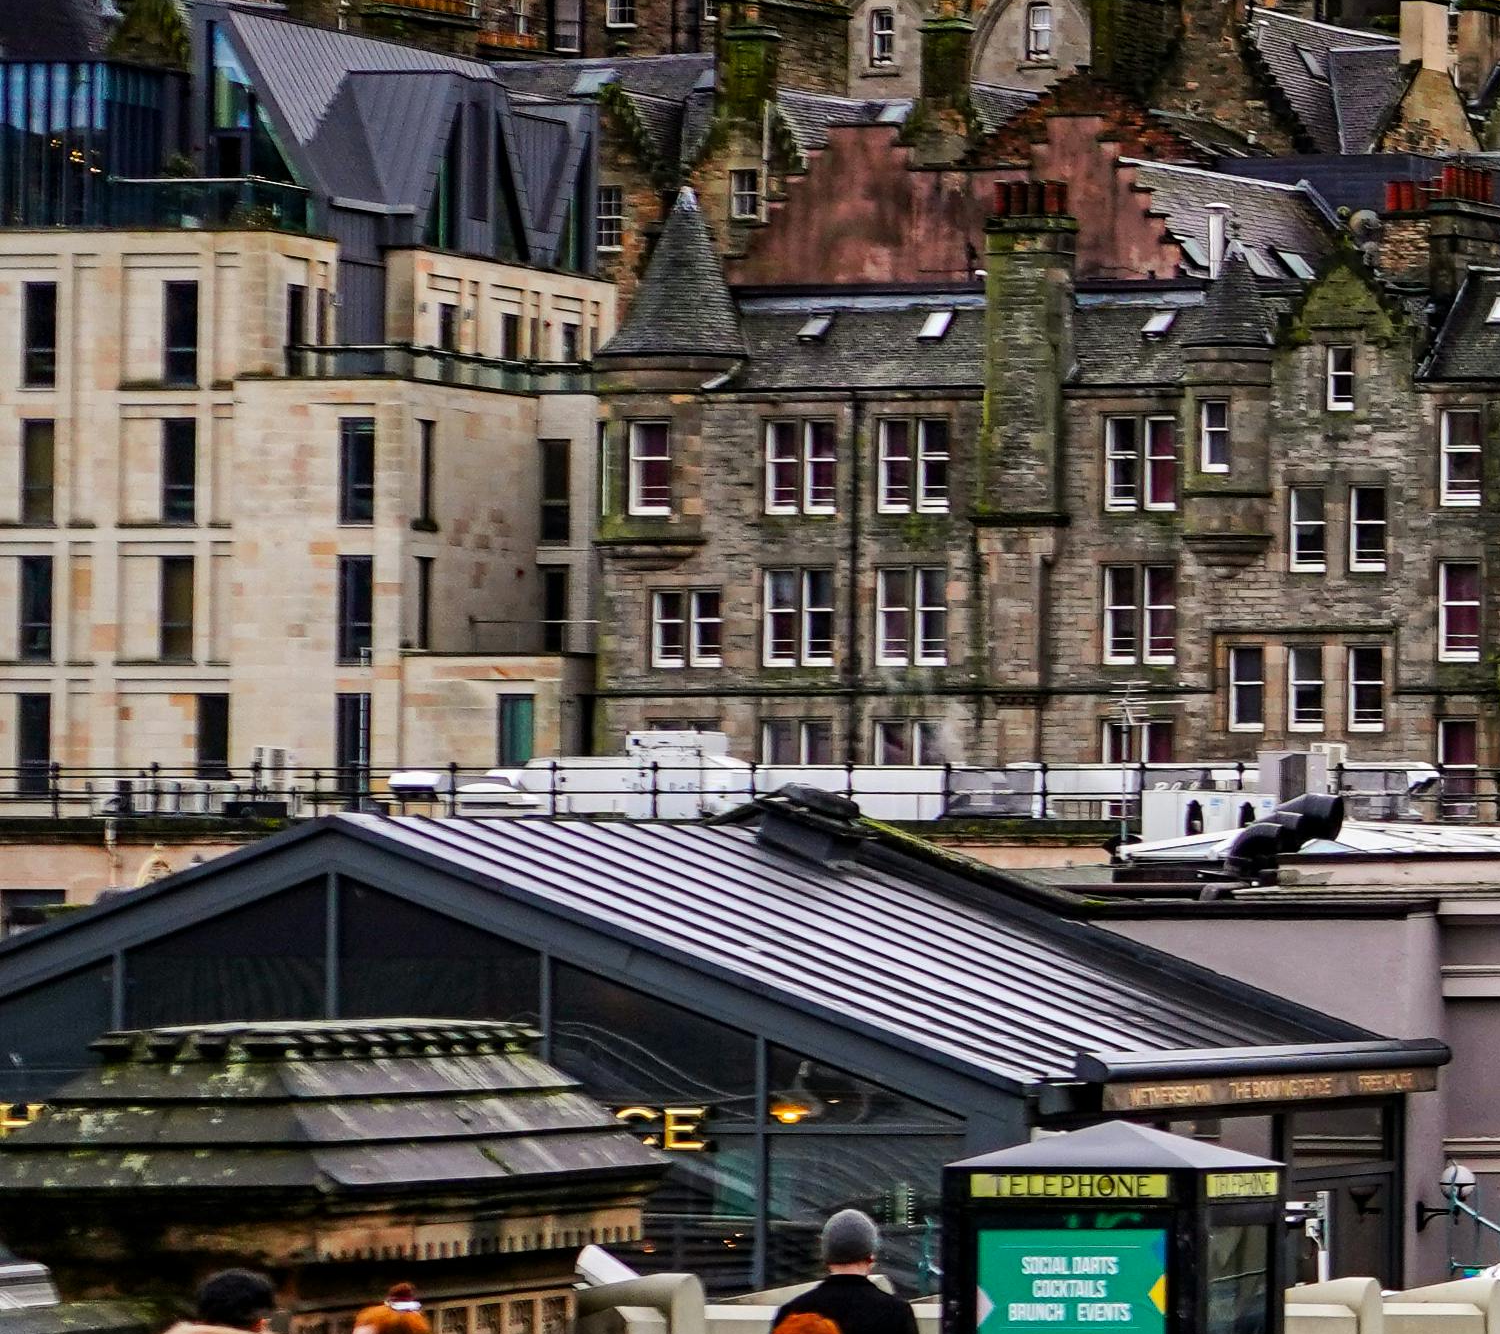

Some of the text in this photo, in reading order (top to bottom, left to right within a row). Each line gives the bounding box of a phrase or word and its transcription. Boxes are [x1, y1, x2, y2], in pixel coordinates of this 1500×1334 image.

[991, 1174, 1152, 1198] TELEPHONE
[1021, 1256, 1119, 1275] SOCIAL DARTS
[1032, 1279, 1107, 1298] COCKTAILS
[1008, 1303, 1132, 1322] BRUNCH EVENTS
